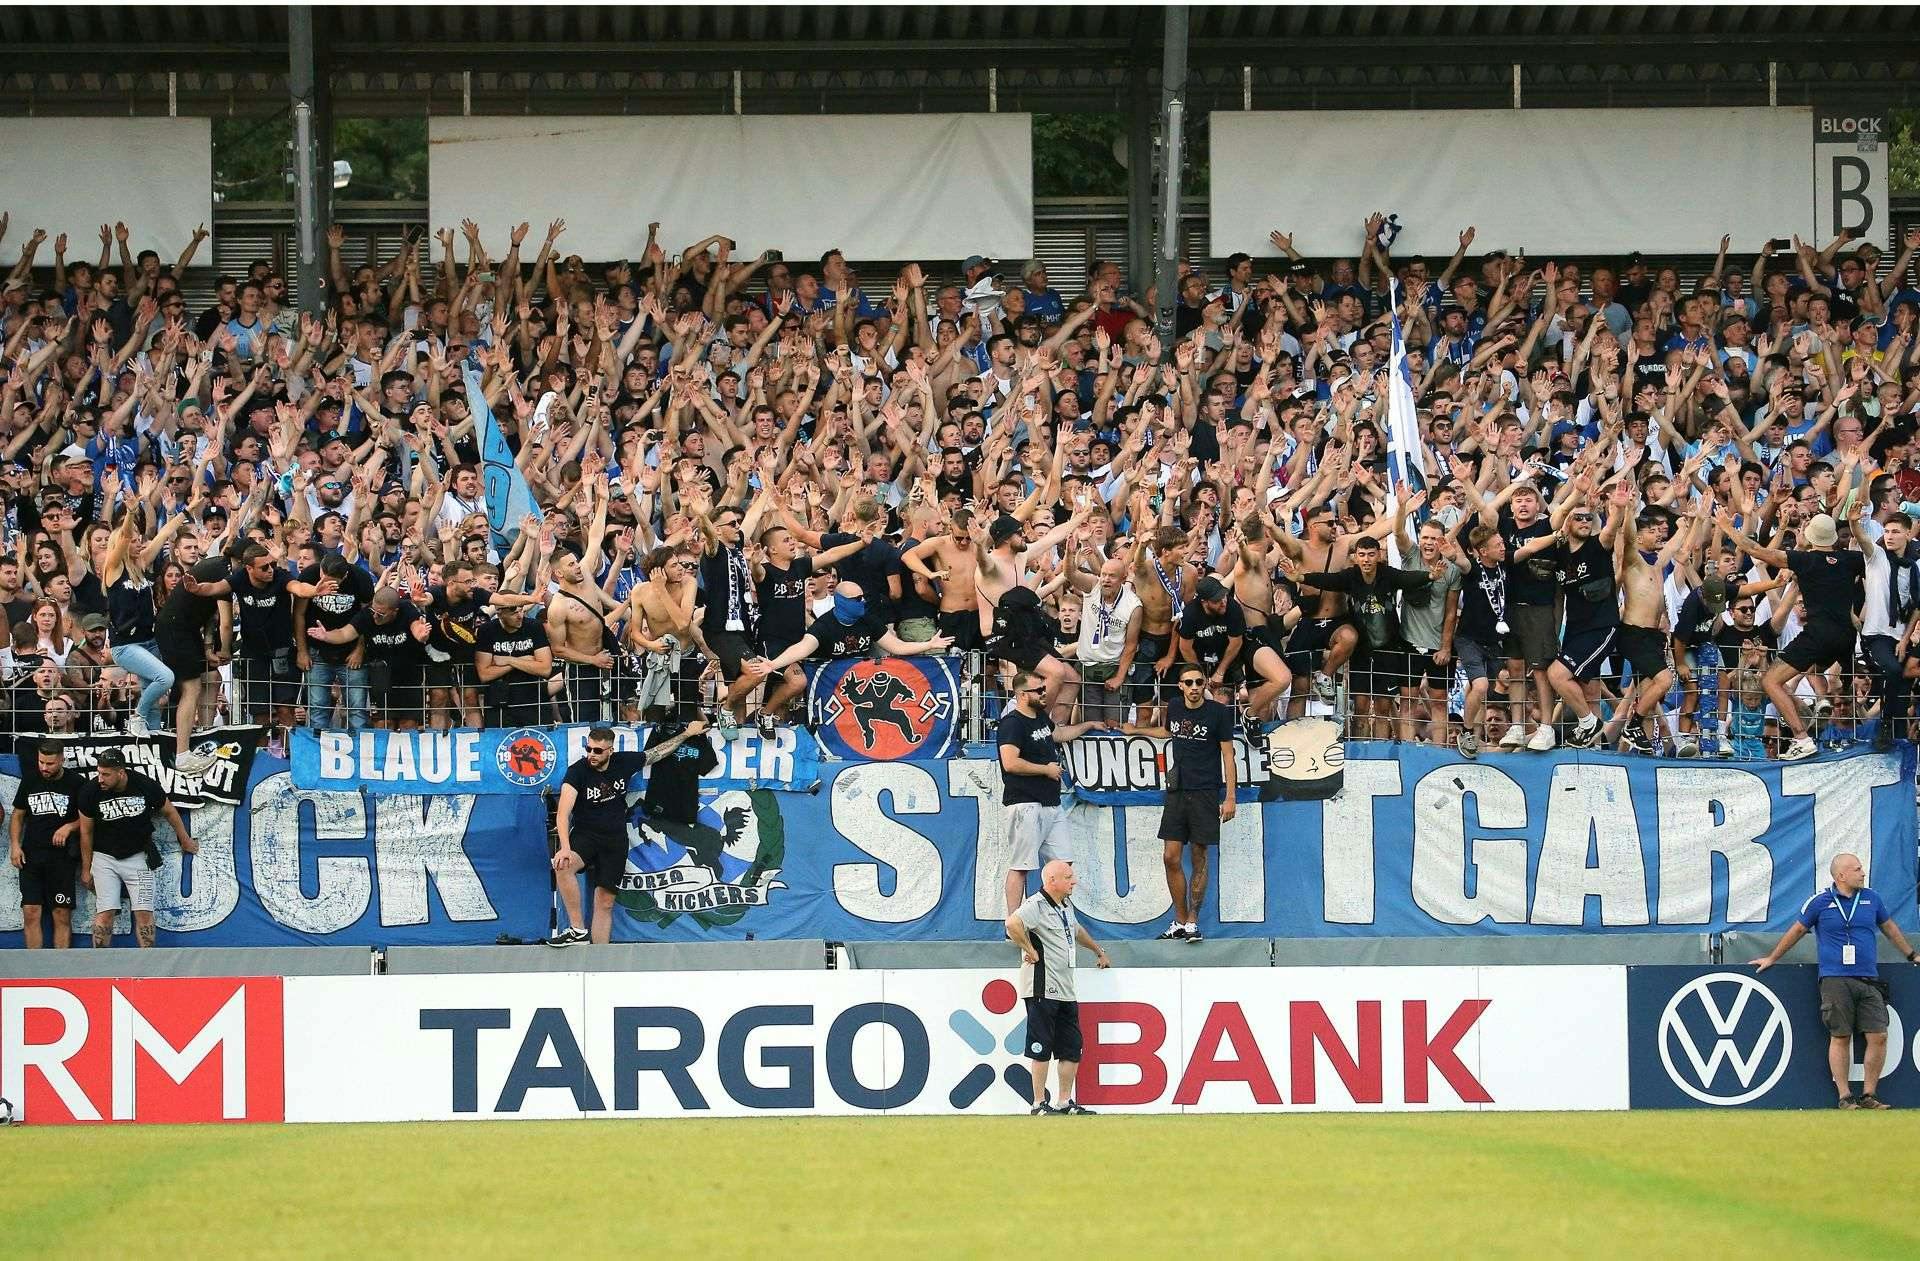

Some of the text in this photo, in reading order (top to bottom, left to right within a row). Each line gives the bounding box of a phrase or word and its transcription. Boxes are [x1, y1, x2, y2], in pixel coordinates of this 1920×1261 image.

[1821, 117, 1882, 133] BLOCK
[1832, 155, 1874, 238] B
[814, 690, 952, 726] 19 95
[320, 726, 797, 783] BLAUE BOBER
[498, 751, 512, 761] 19
[586, 786, 601, 800] BB
[0, 770, 498, 936] OCK
[621, 869, 684, 889] FORZA
[664, 886, 760, 910] KICKERS
[418, 999, 1496, 1113] TARGO BANK
